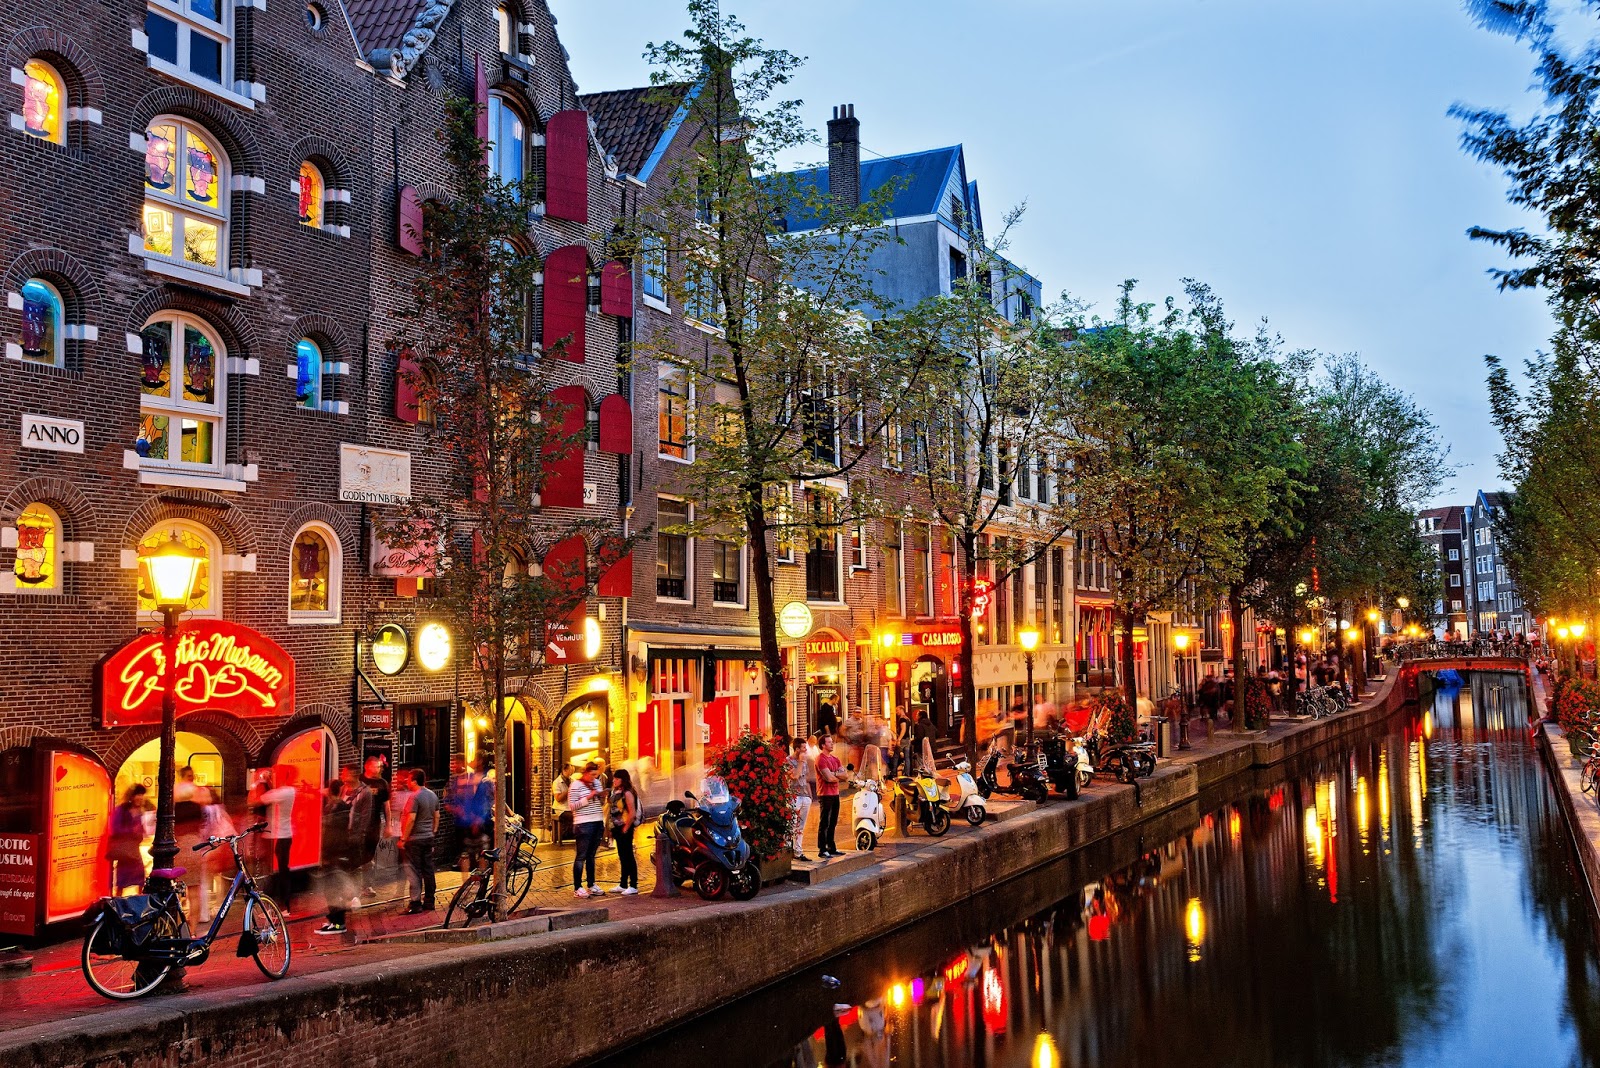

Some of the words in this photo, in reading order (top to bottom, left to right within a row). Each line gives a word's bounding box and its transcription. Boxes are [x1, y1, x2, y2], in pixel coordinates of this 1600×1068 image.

[27, 423, 80, 445] ANNO
[922, 632, 943, 646] CASA
[806, 641, 850, 654] EXCALIBUR
[120, 635, 210, 710] Ertic
[208, 632, 283, 690] Museum
[363, 714, 389, 723] MUSEUM
[7, 755, 20, 766] 54
[54, 785, 72, 793] EROTIC
[72, 782, 95, 790] MUSEUM
[13, 888, 22, 898] the
[22, 891, 35, 900] ages
